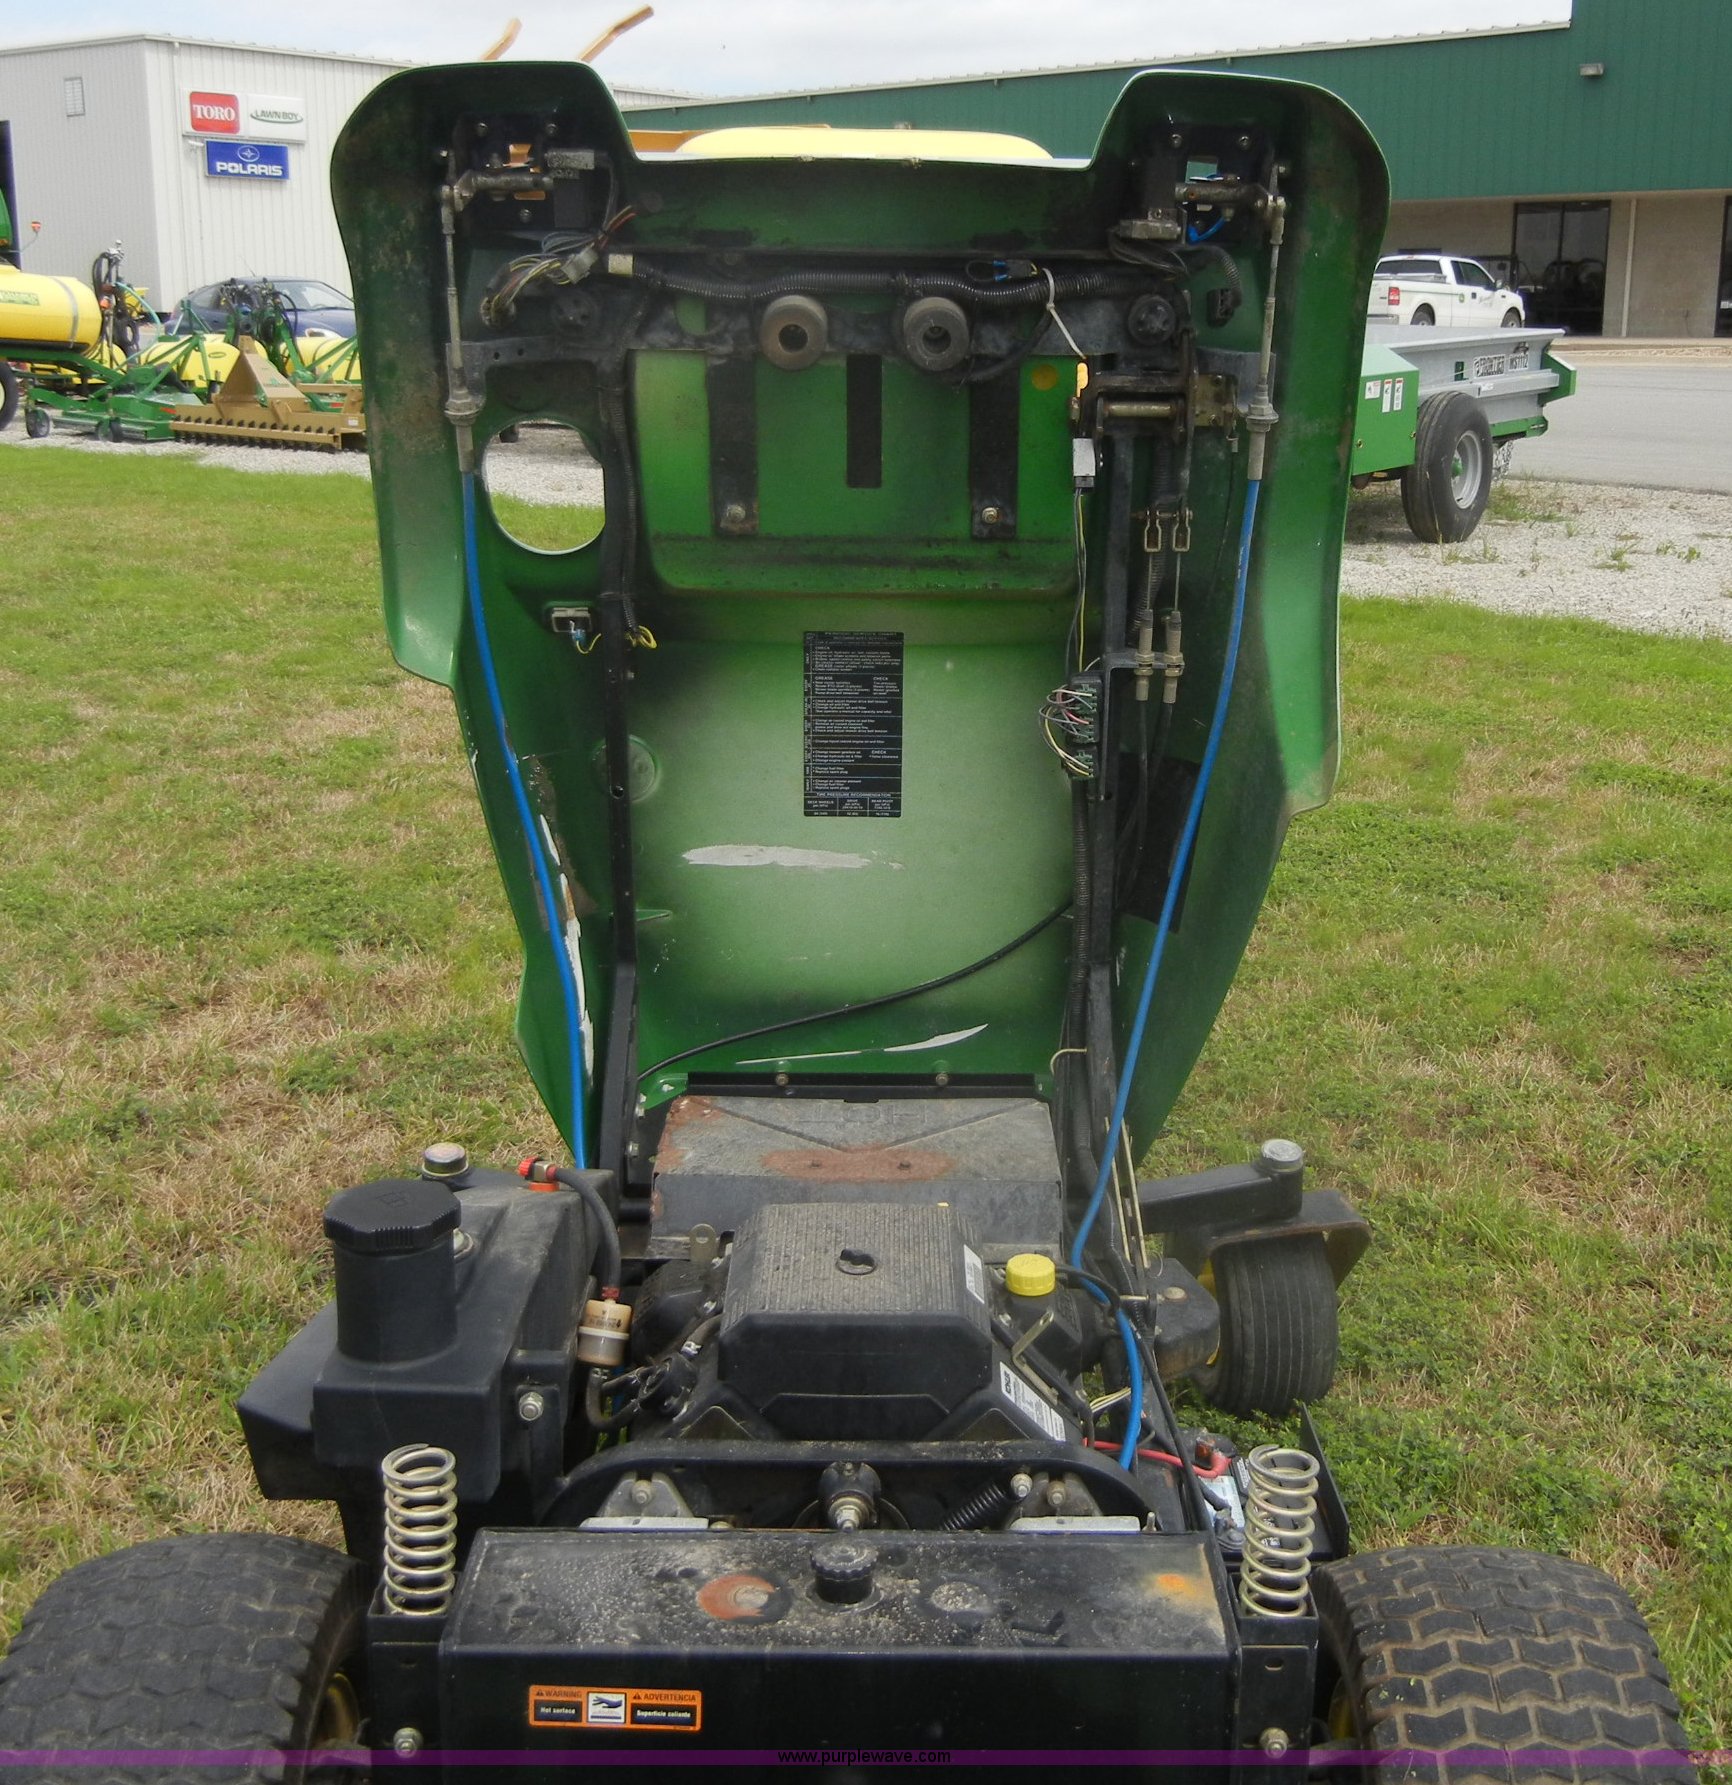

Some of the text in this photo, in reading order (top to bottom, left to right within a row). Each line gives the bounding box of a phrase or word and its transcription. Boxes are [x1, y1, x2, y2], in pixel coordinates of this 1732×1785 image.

[193, 104, 236, 121] TORO
[215, 161, 283, 176] POLARIS
[545, 1690, 582, 1698] WARNING
[643, 1692, 697, 1702] ADVERTENCIA
[636, 1709, 667, 1718] Superficie
